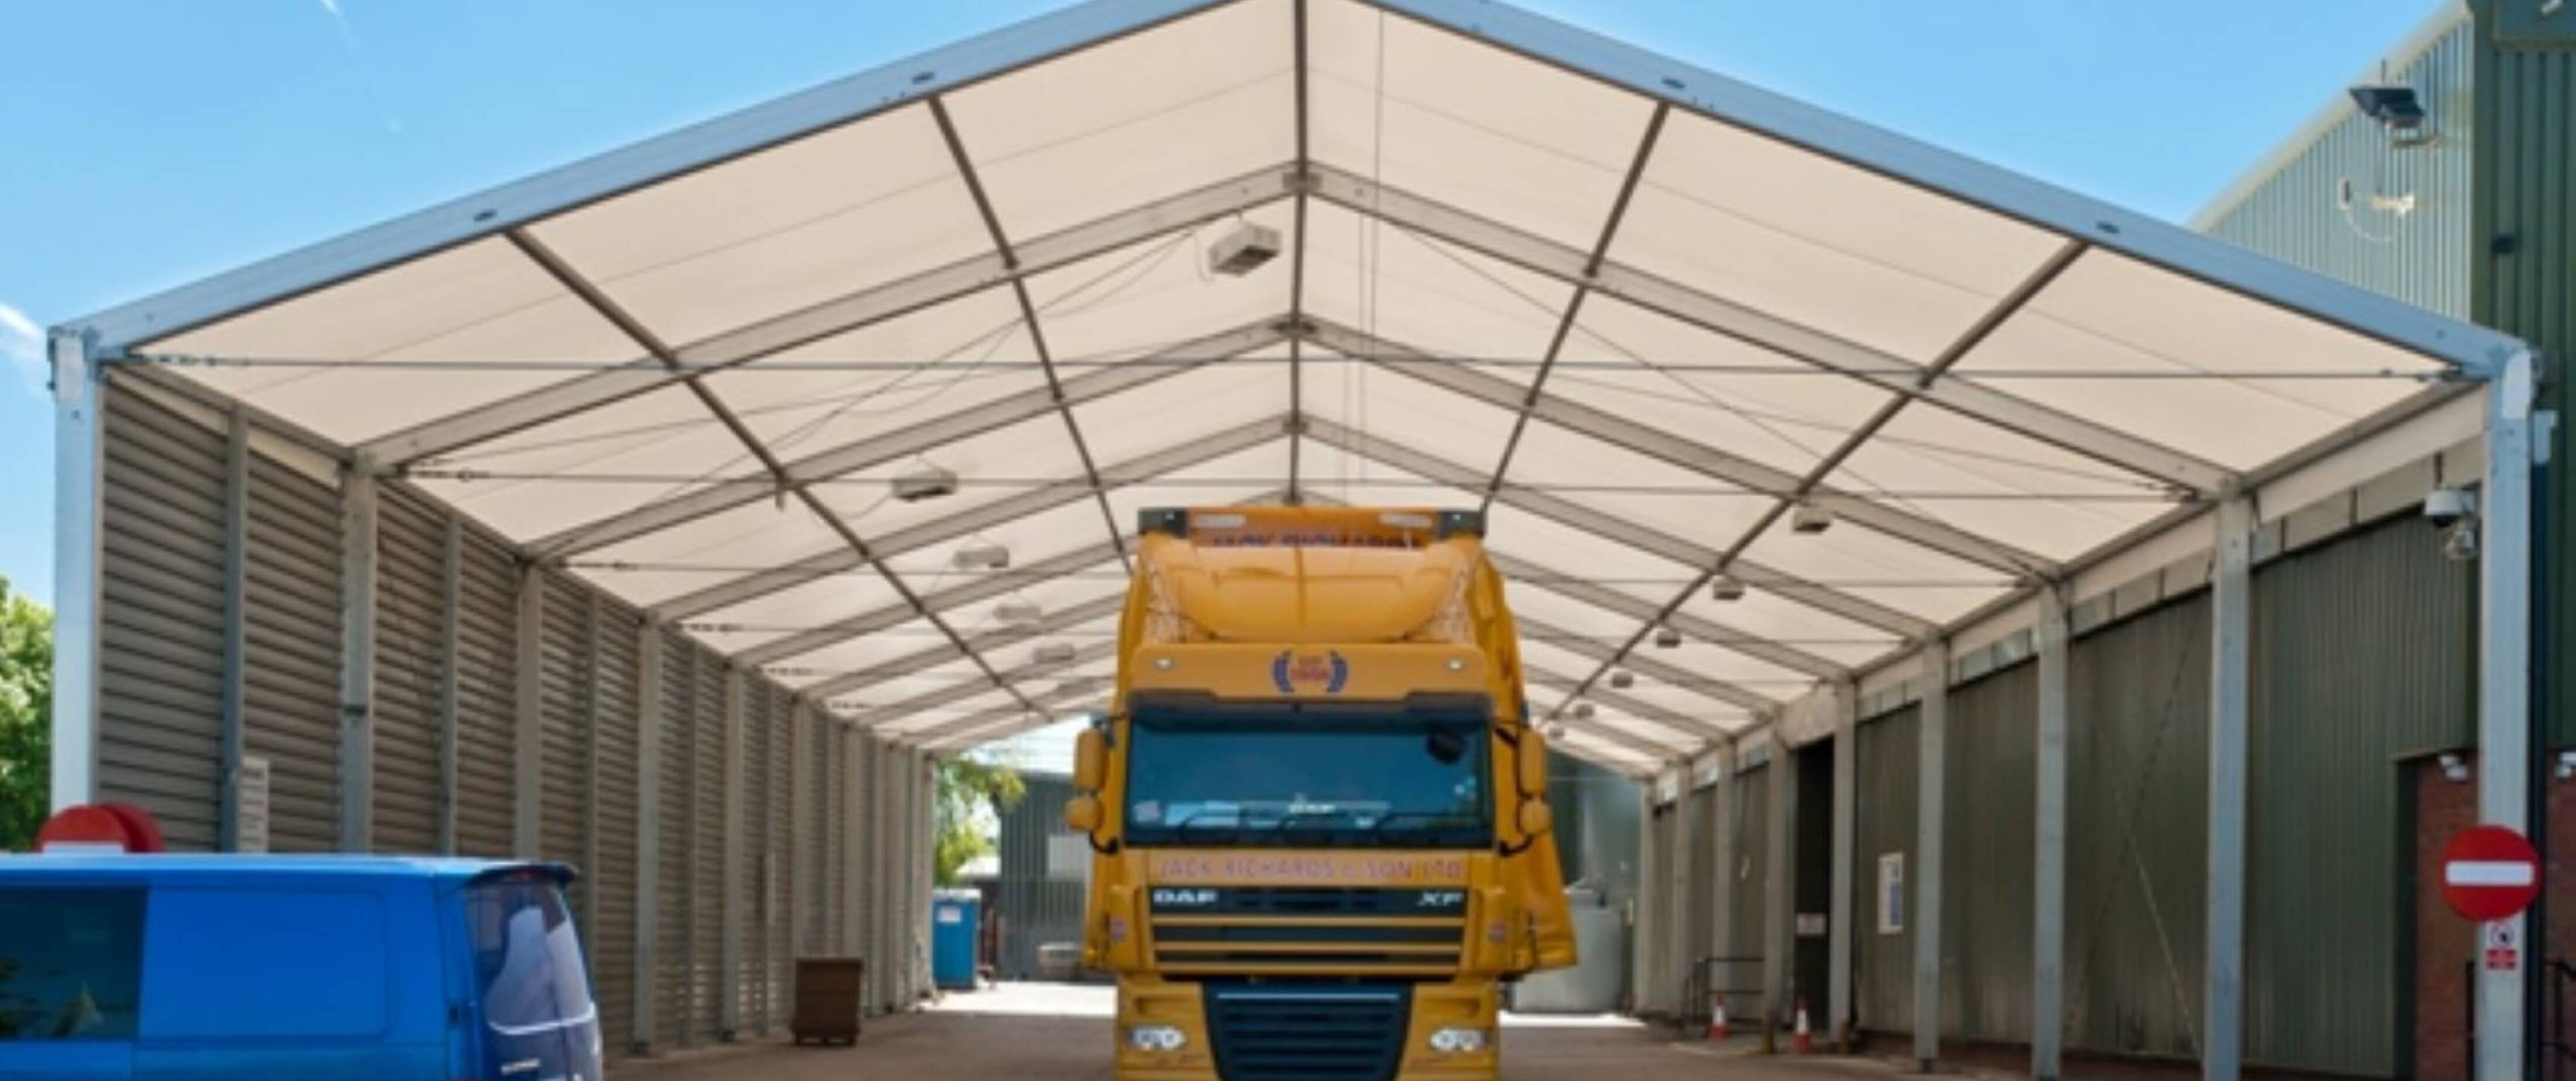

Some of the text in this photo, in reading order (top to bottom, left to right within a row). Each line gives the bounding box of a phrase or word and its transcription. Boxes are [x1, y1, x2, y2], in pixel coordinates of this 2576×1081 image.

[1159, 857, 1214, 878] JACK
[1223, 857, 1335, 878] RICHARDS
[1365, 858, 1413, 878] SON
[1422, 858, 1462, 878] LTD
[1153, 889, 1218, 903] DAF
[1418, 891, 1464, 906] XF
